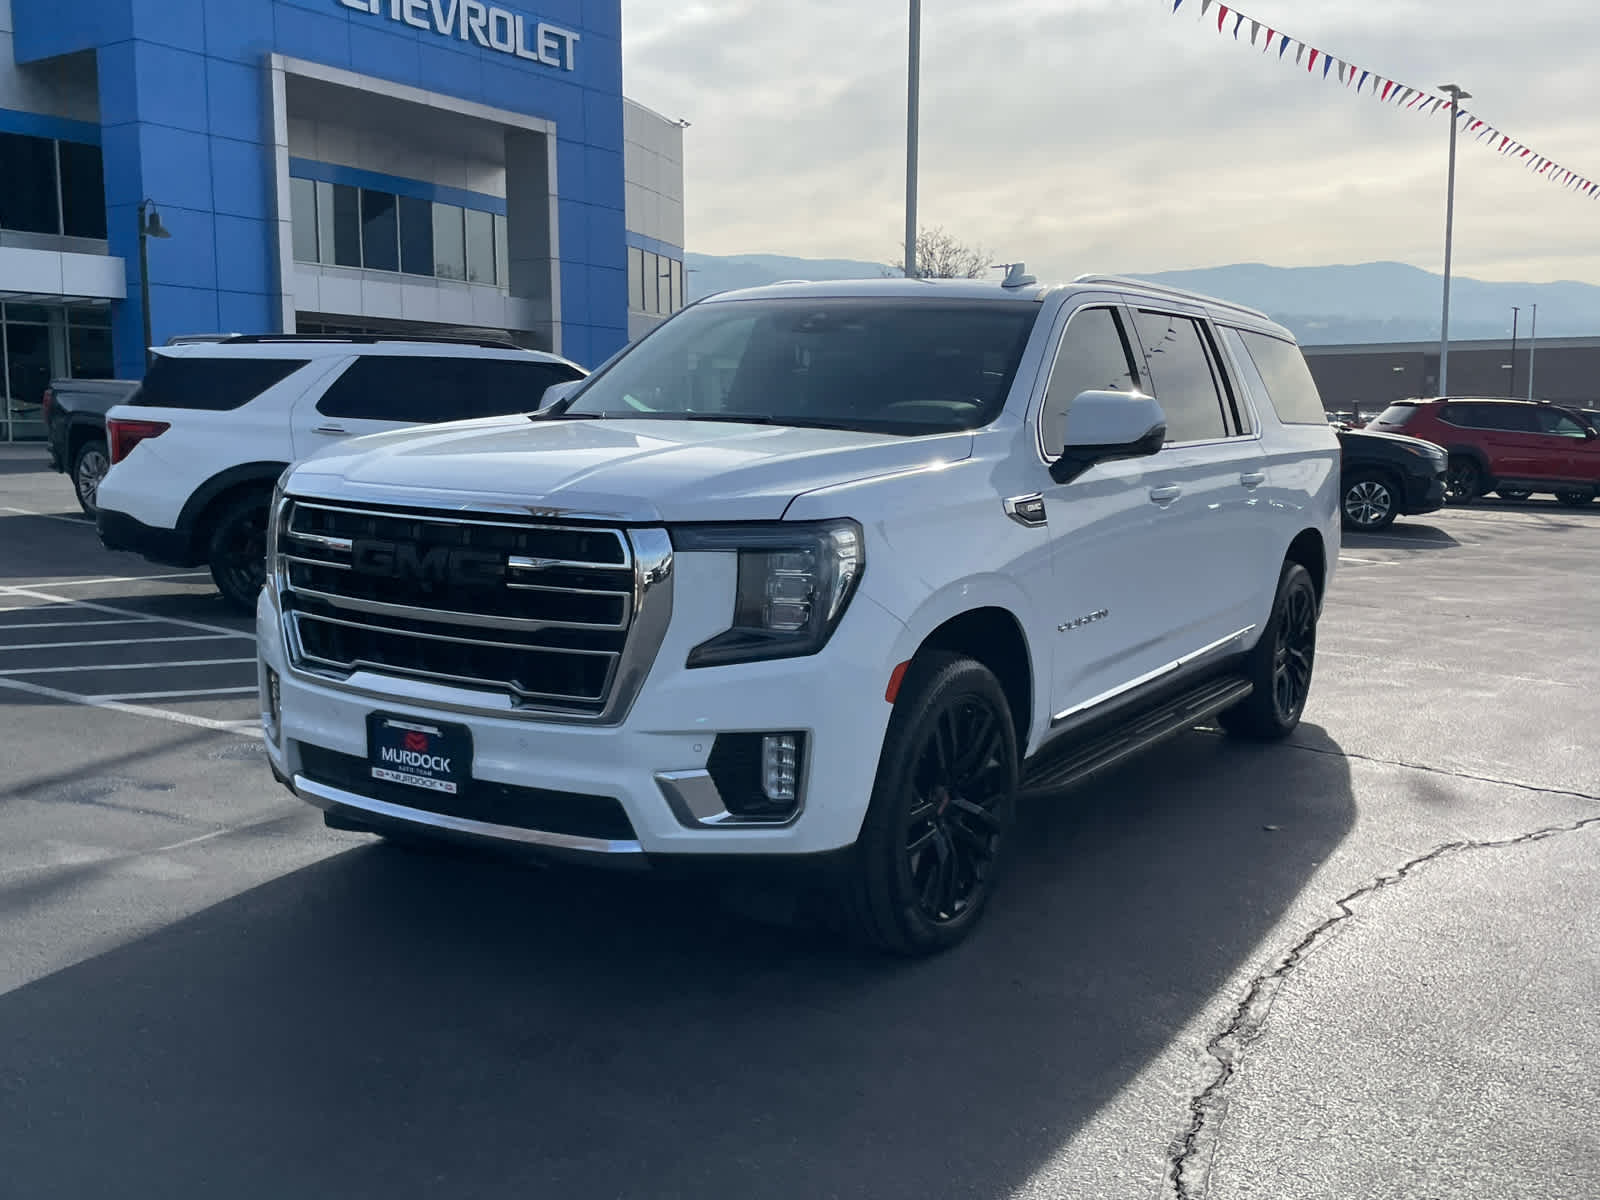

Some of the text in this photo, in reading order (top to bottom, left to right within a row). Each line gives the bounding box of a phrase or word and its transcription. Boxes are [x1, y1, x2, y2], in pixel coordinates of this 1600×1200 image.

[1027, 503, 1042, 512] GMC
[352, 537, 505, 583] GMC
[381, 746, 451, 773] MURDOCK
